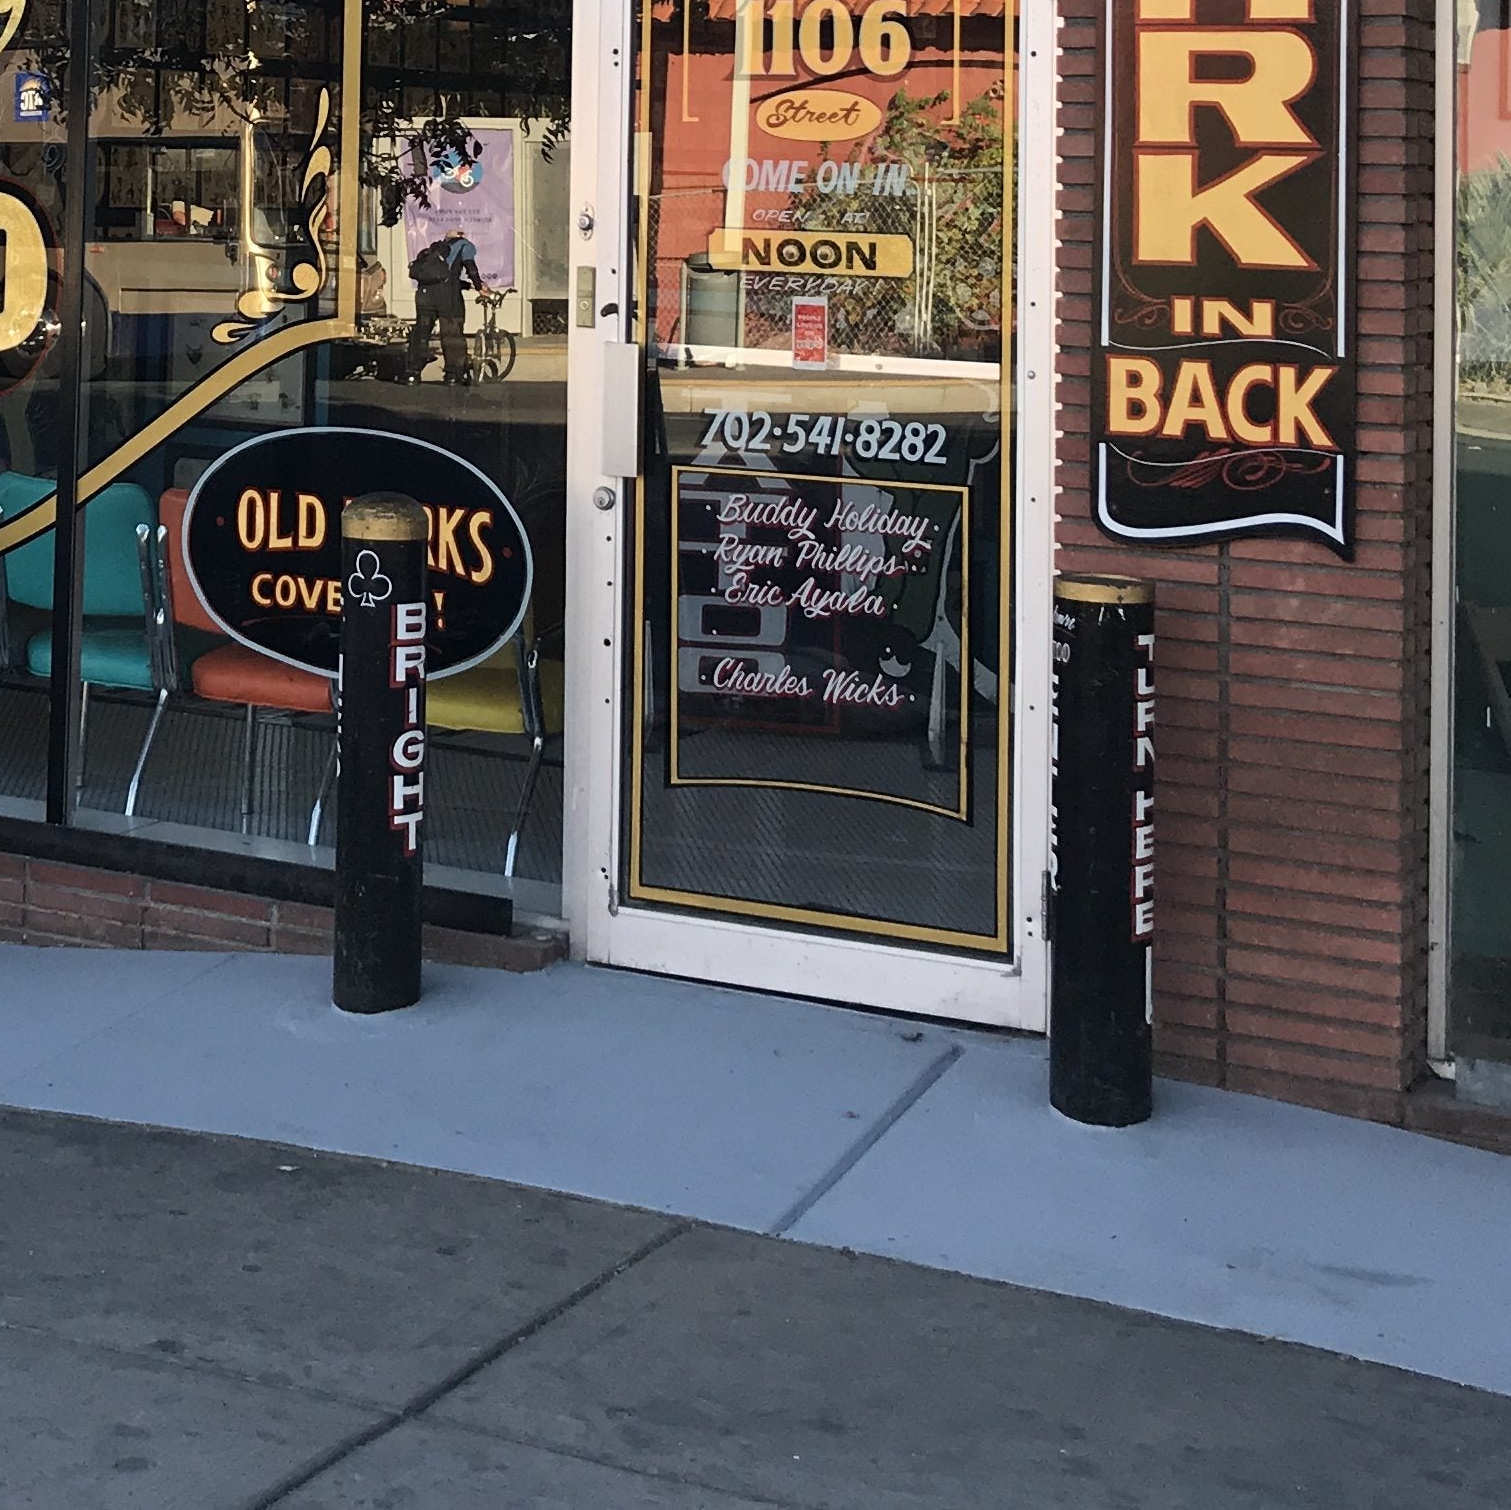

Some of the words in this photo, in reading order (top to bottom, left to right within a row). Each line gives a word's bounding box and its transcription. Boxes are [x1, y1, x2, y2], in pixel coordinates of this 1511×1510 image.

[766, 97, 861, 129] Street
[722, 158, 809, 193] COME
[816, 160, 861, 195] ON
[752, 208, 812, 224] OPEN
[741, 236, 877, 271] NOON
[1170, 295, 1277, 339] IN
[1104, 353, 1341, 451] BACK
[236, 487, 328, 550] OLD
[715, 492, 818, 541] Buddy
[823, 498, 933, 553] Holiday
[713, 533, 784, 573] Ryan
[795, 538, 903, 581] Phillips
[723, 571, 784, 607] Eric
[785, 576, 885, 619] Ayala
[713, 656, 813, 696] Charles
[822, 668, 905, 707] Wicks
[390, 601, 427, 856] BRIGHT
